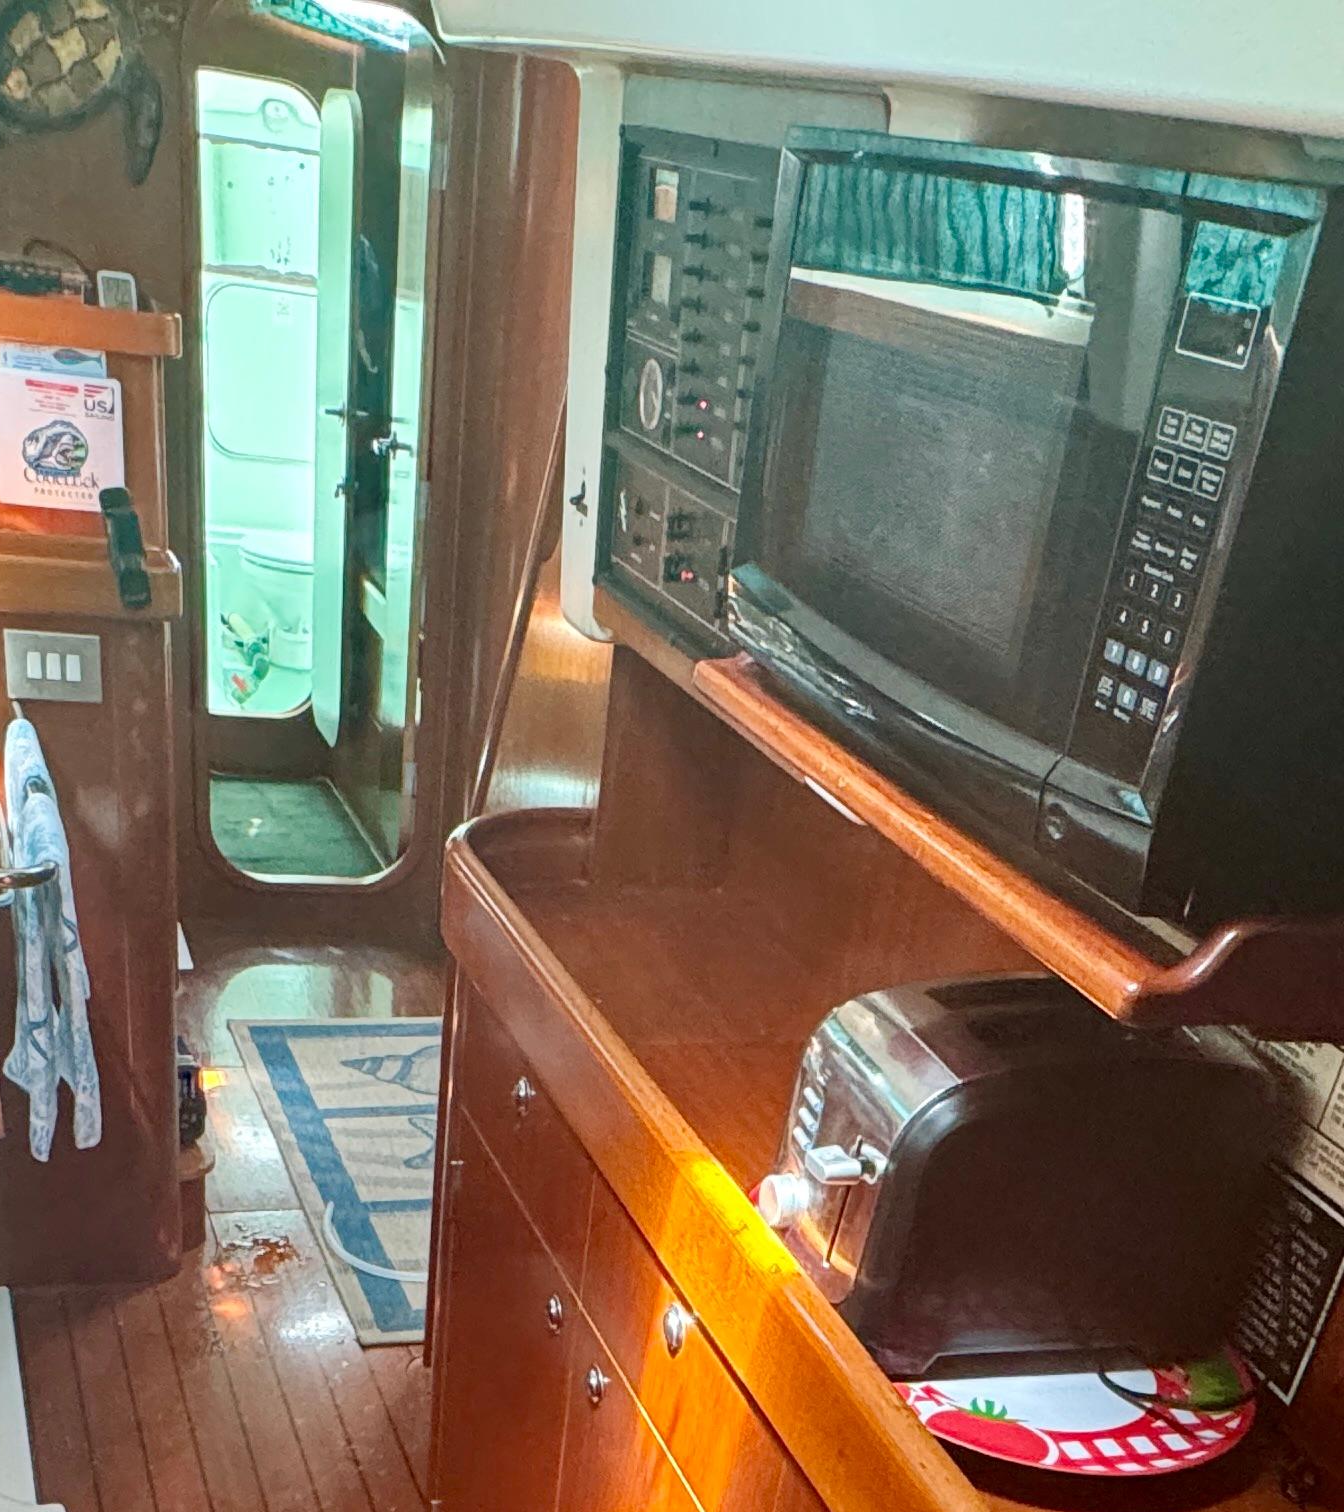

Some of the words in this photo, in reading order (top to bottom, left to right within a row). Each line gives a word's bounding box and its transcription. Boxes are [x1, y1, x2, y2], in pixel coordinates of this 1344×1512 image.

[84, 399, 108, 414] US
[34, 487, 94, 500] PROTECTED
[1128, 573, 1136, 588] 1
[1150, 583, 1159, 598] 2
[1174, 593, 1183, 608] 3
[1119, 609, 1128, 624] 4
